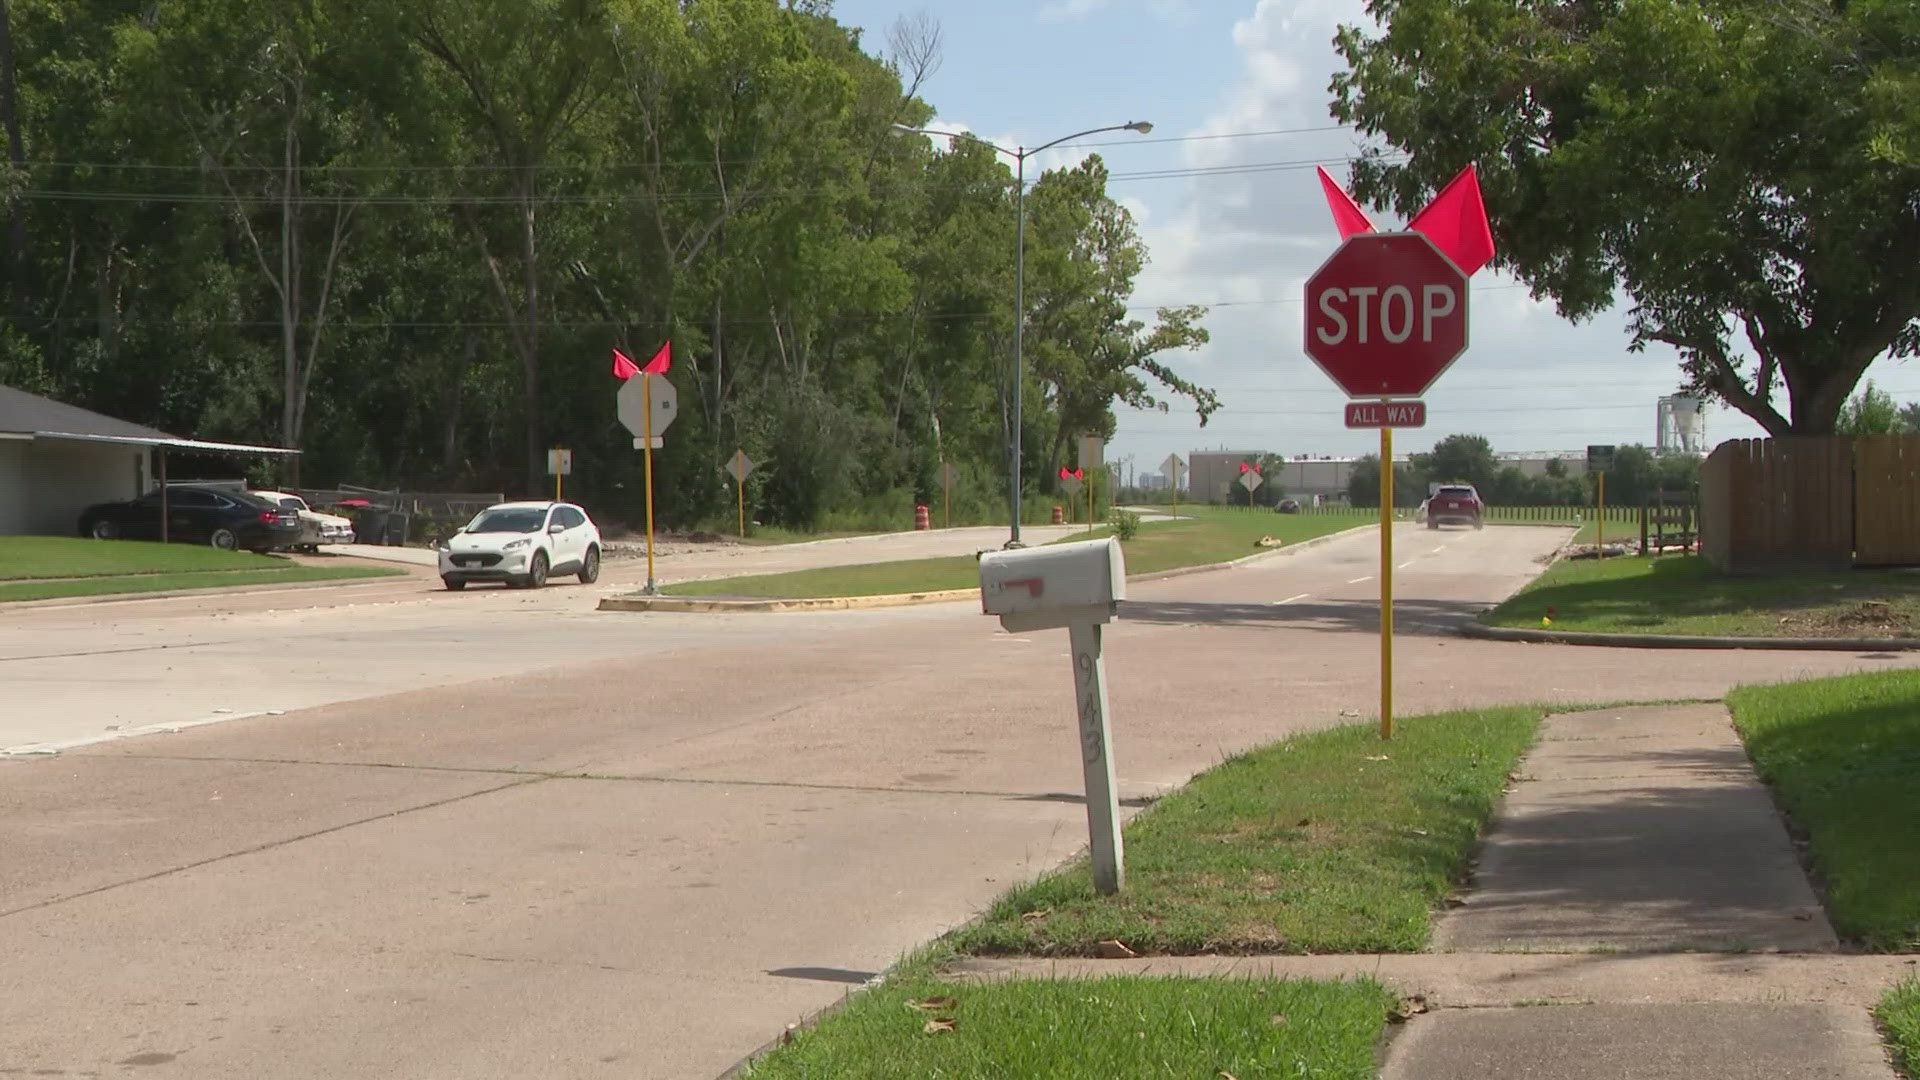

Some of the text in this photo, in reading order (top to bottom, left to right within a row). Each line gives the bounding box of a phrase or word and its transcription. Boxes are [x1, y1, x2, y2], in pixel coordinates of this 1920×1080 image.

[1316, 285, 1456, 345] STOP
[1352, 406, 1418, 423] ALL WAY
[1078, 652, 1101, 764] 943
